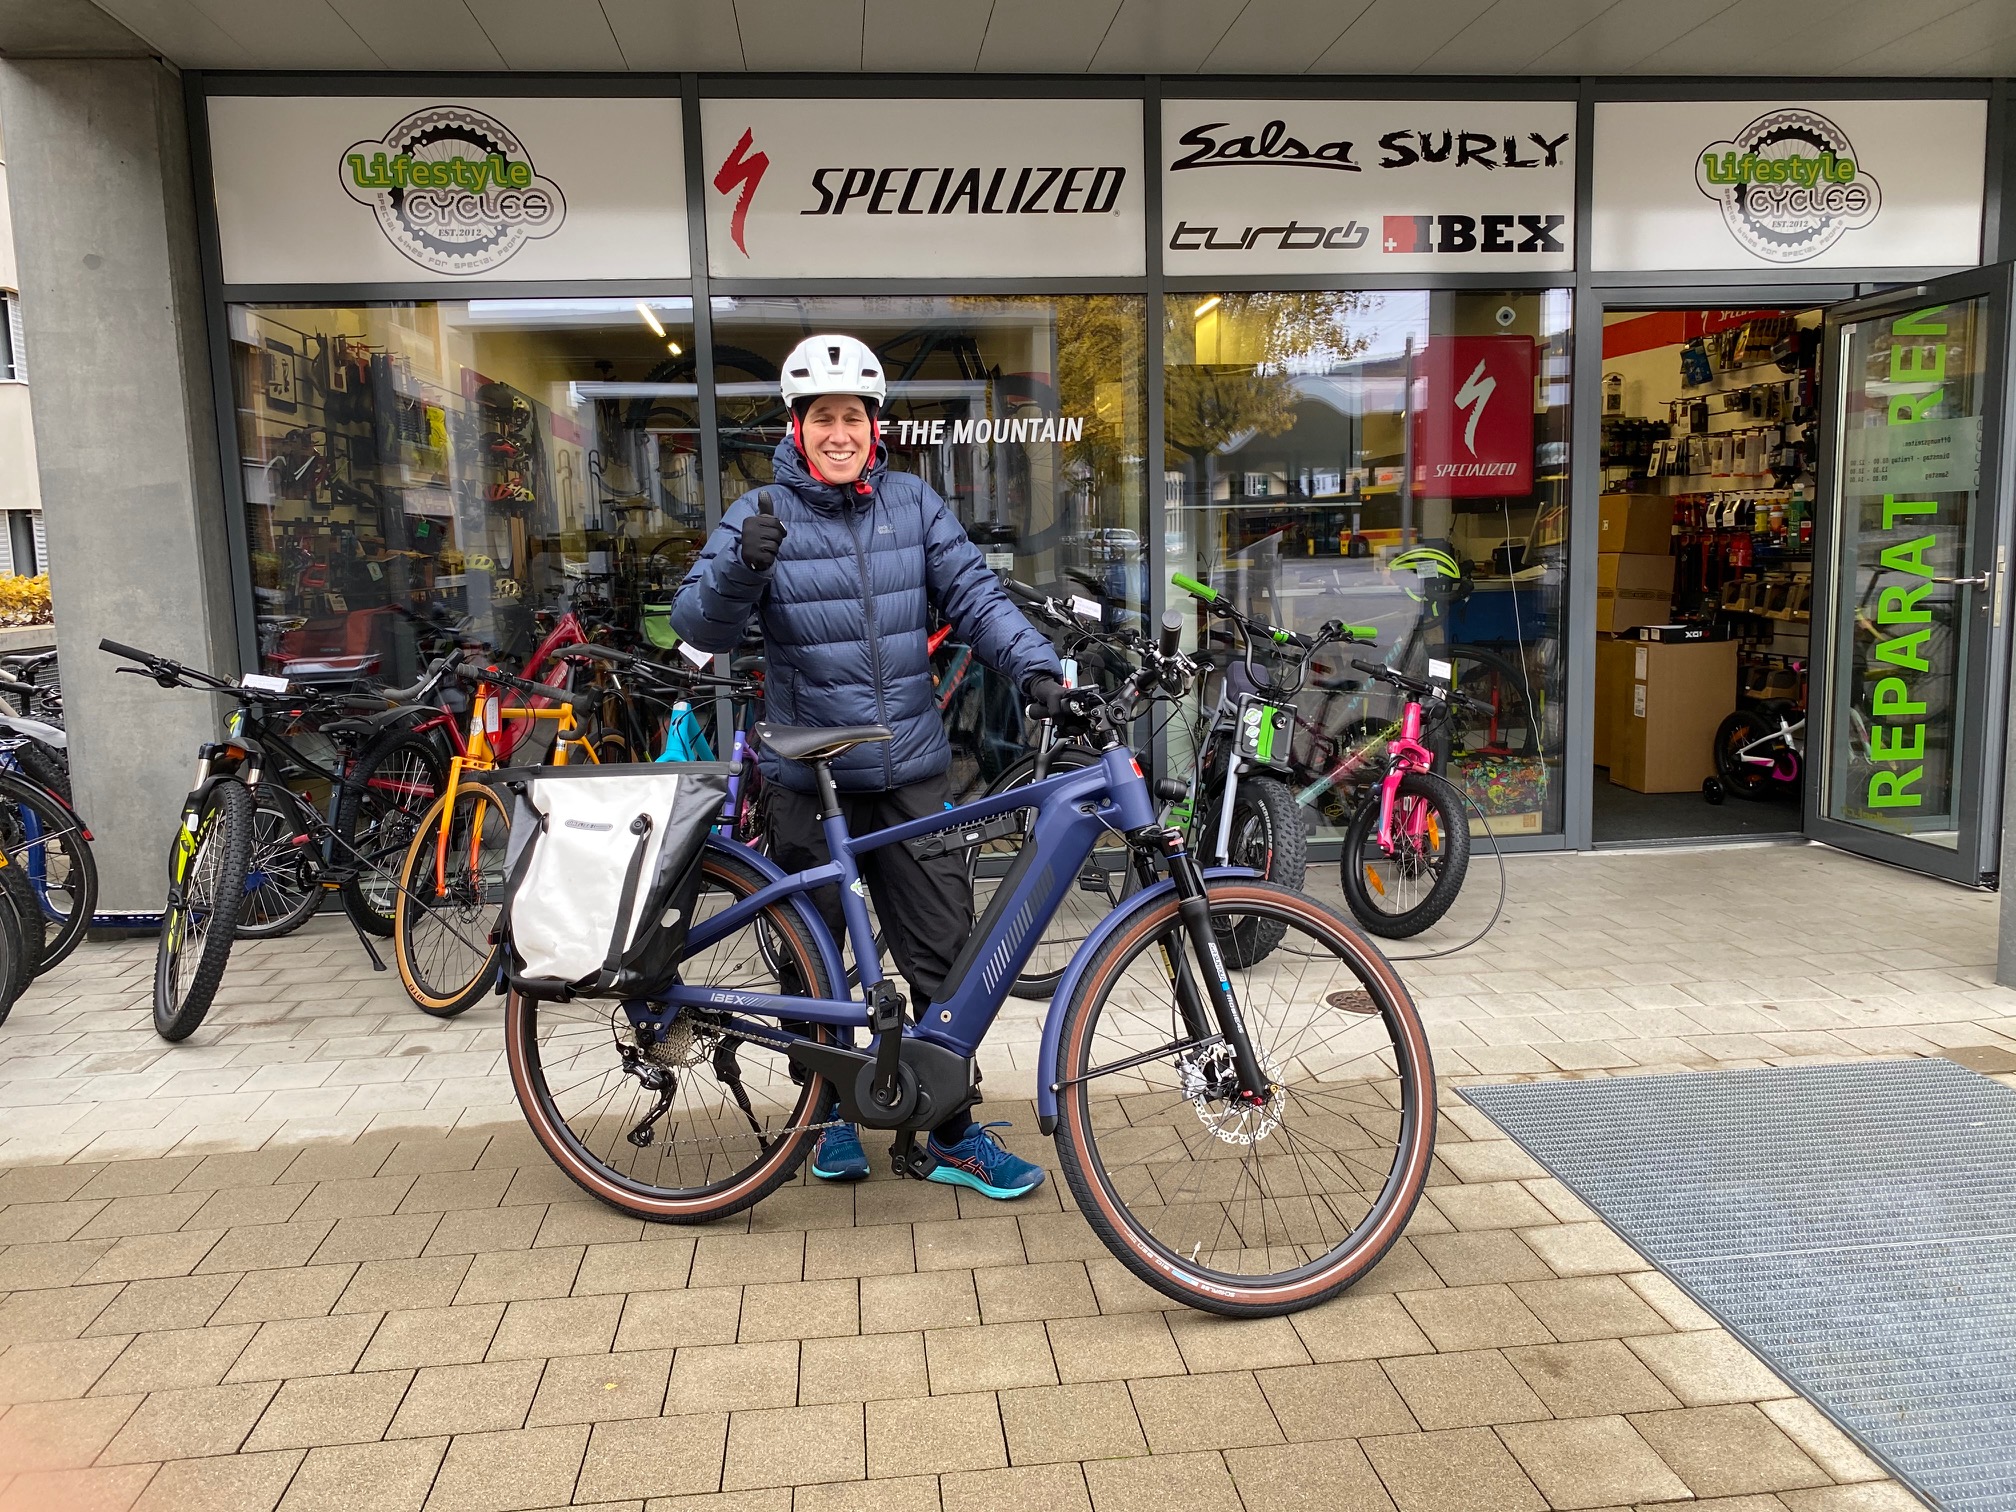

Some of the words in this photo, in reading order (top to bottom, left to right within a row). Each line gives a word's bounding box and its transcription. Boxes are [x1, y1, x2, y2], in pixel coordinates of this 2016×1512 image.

[1170, 120, 1361, 171] Salsa
[1378, 128, 1570, 171] SURLY
[348, 153, 531, 192] lifestyle
[1704, 153, 1855, 187] lifestyle
[407, 193, 550, 221] CYCLES
[800, 167, 1126, 215] SPECIALIZED
[1748, 188, 1867, 214] CYCLES
[1169, 220, 1370, 251] turbo
[1413, 215, 1565, 254] IBEX
[899, 419, 946, 445] THE
[952, 416, 1084, 444] MOUNTAIN
[1433, 463, 1517, 478] SPECIALIZED
[1868, 304, 1949, 808] REPARATREN
[710, 993, 744, 1006] IBEX
